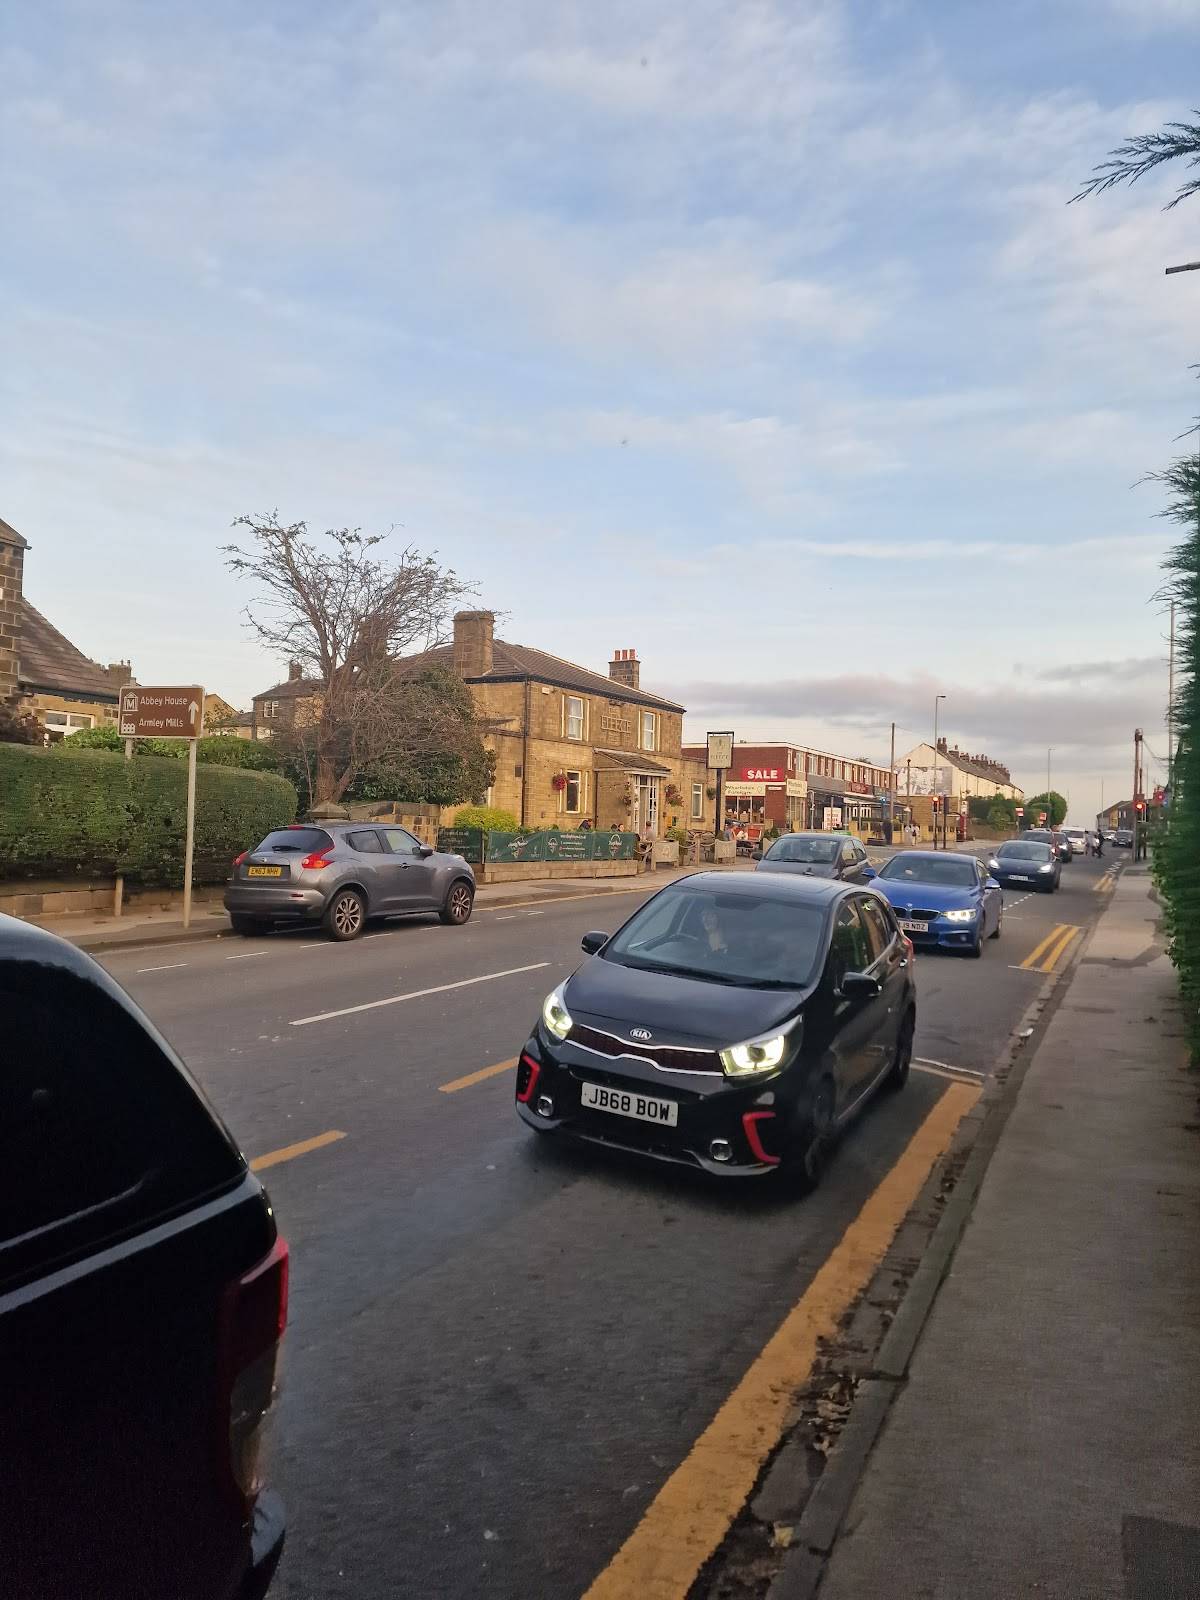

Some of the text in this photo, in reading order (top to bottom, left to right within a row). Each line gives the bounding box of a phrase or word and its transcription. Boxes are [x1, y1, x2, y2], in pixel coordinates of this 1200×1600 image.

[140, 696, 188, 706] Abbey House
[139, 718, 184, 728] Armley Mills
[747, 769, 778, 780] SALE
[632, 1029, 649, 1039] KIA
[589, 1088, 671, 1121] JB68 BOW
